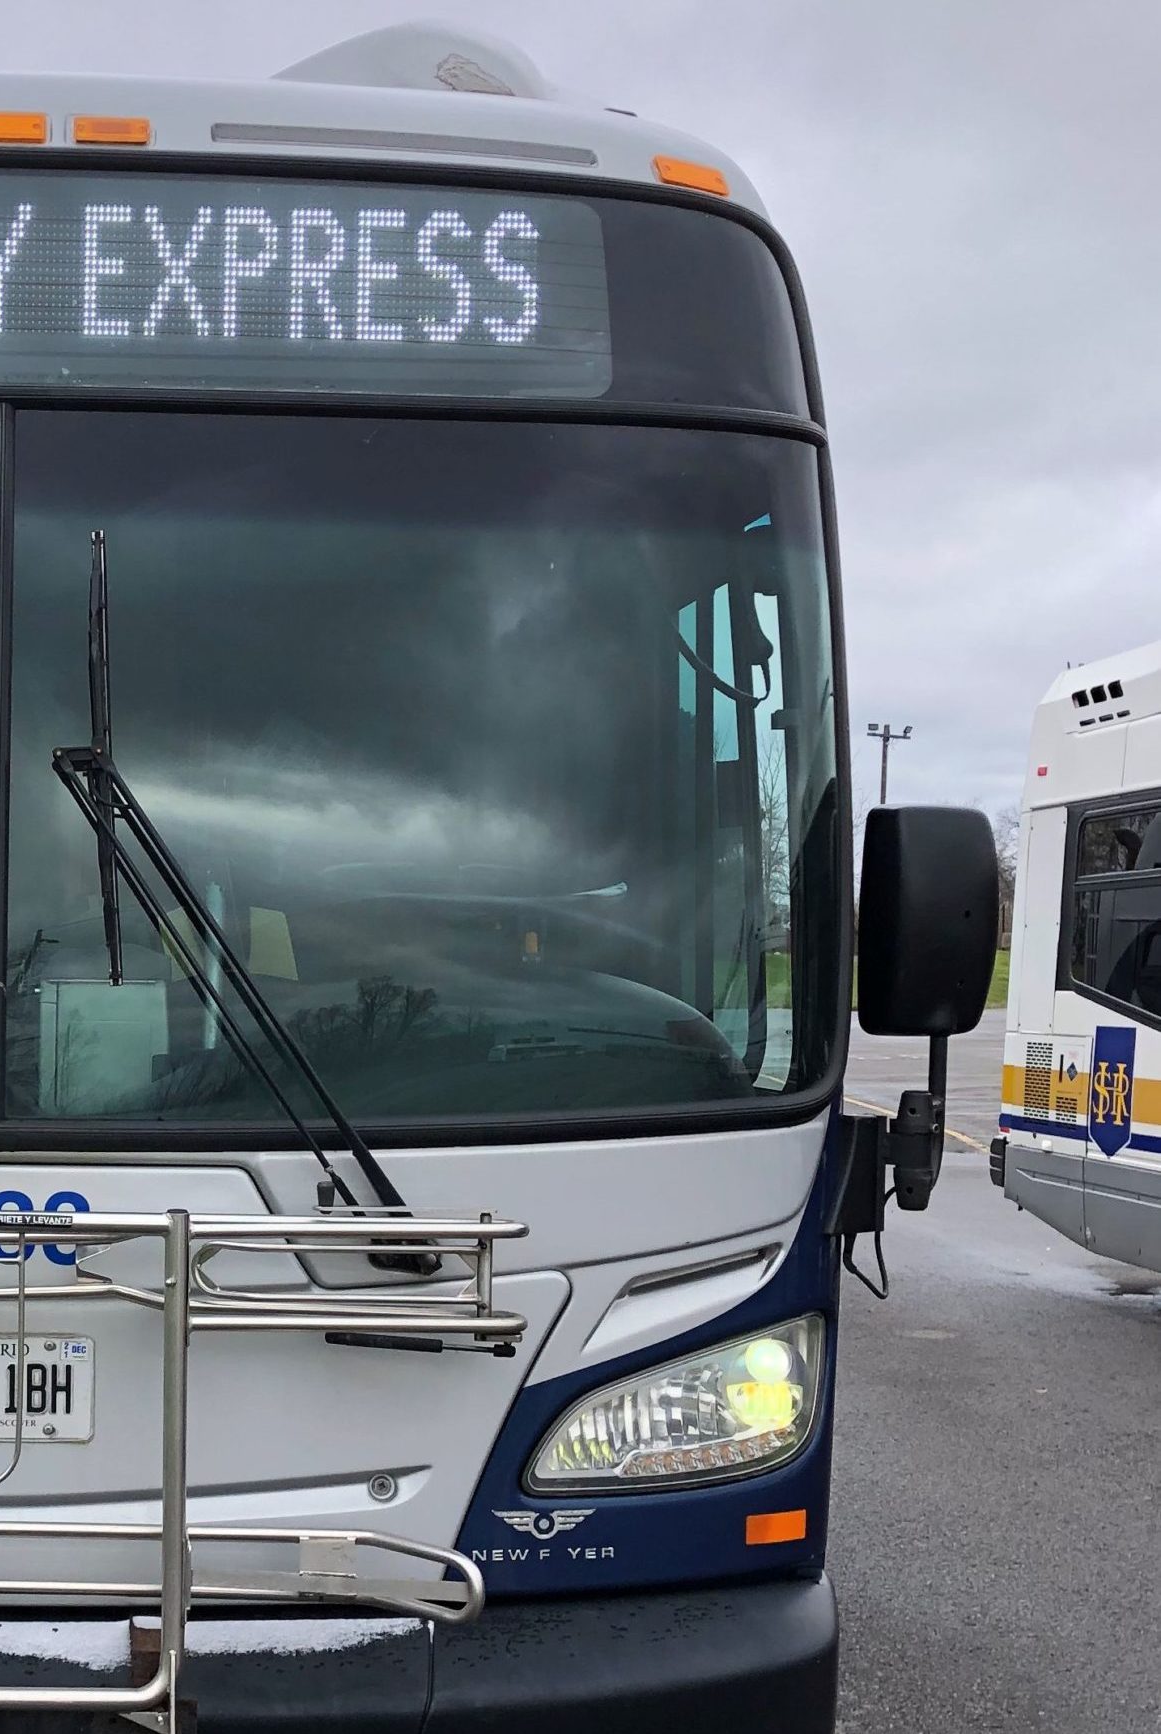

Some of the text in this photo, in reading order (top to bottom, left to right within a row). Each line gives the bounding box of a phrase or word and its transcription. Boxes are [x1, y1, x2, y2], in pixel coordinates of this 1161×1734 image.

[82, 203, 541, 343] EXPRESS
[25, 1216, 31, 1224] Y
[33, 1216, 72, 1225] LEVANTE
[72, 1345, 86, 1354] DEC
[5, 1364, 71, 1414] 1BH
[472, 1547, 614, 1561] NEW FYER
